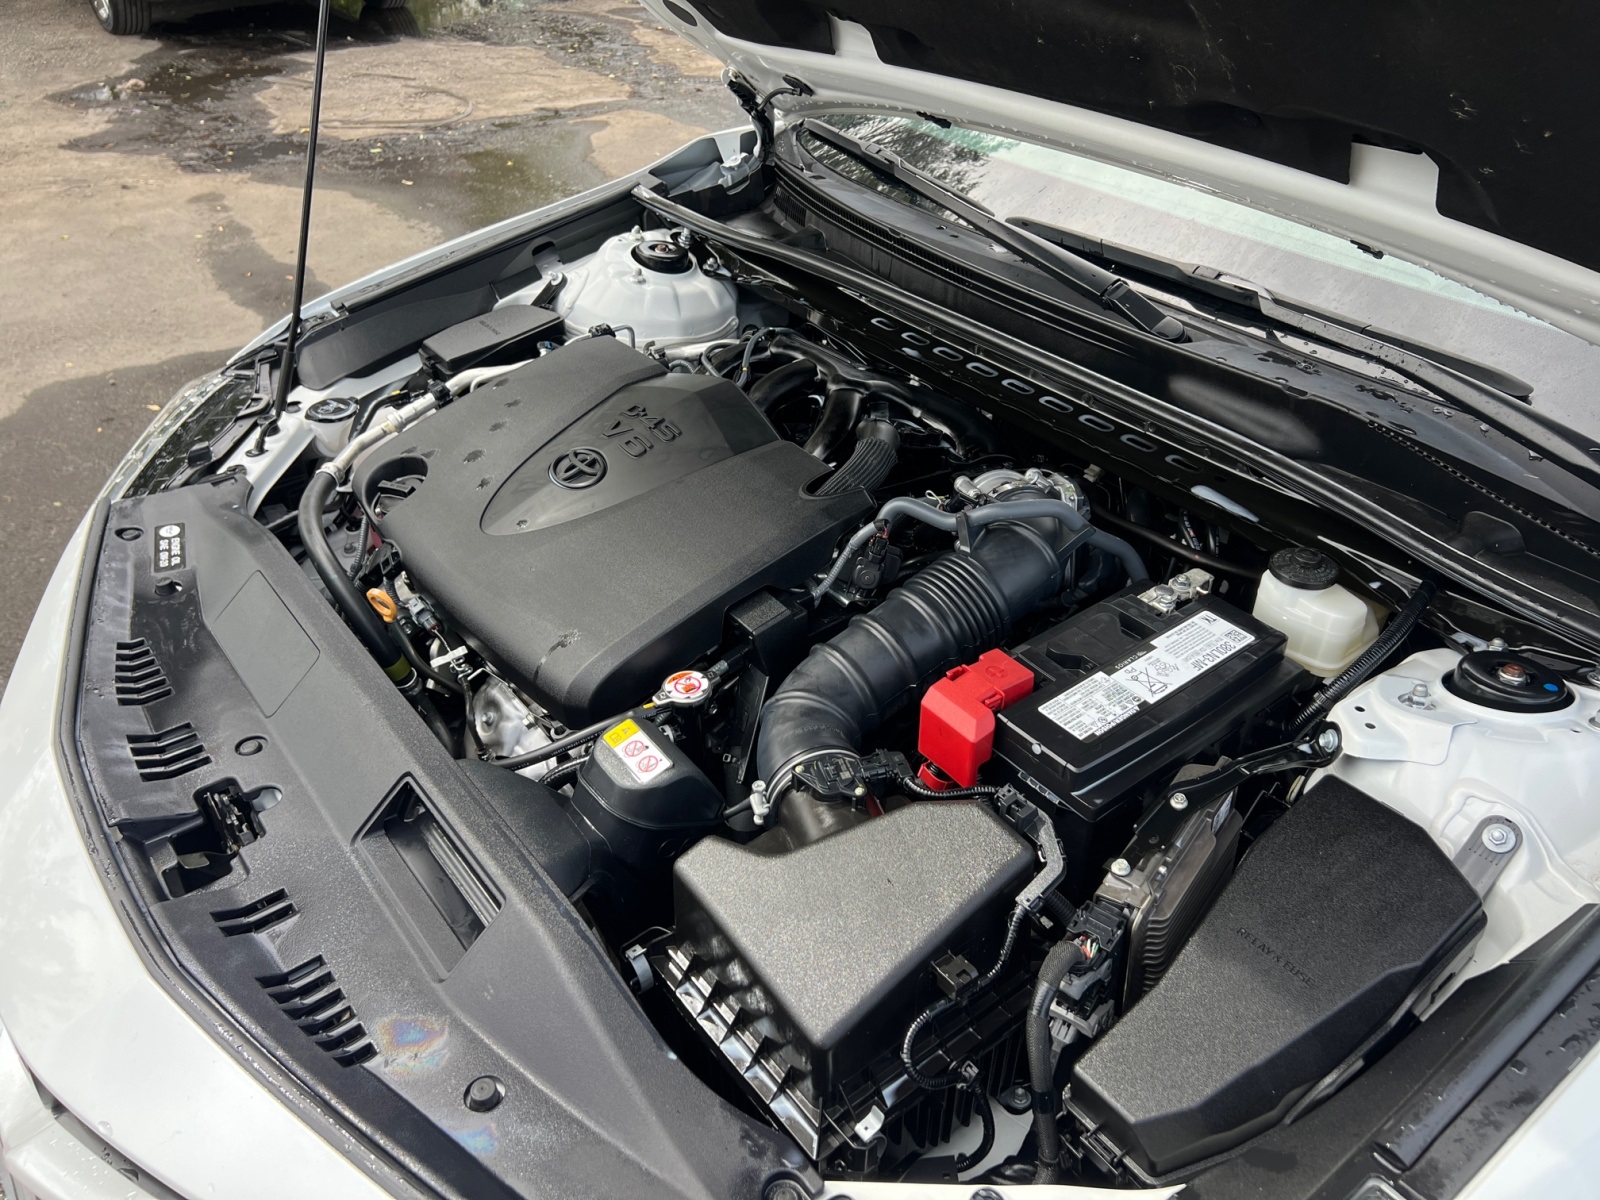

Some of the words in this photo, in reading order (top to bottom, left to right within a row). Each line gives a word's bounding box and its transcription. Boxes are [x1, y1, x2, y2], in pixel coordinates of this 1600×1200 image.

[602, 419, 655, 459] V6
[1113, 653, 1139, 670] CLARIOS
[1123, 666, 1138, 675] Pb
[1187, 641, 1237, 671] 380LN3-MF
[1237, 928, 1274, 954] RELAY
[1283, 961, 1315, 986] FUSE
